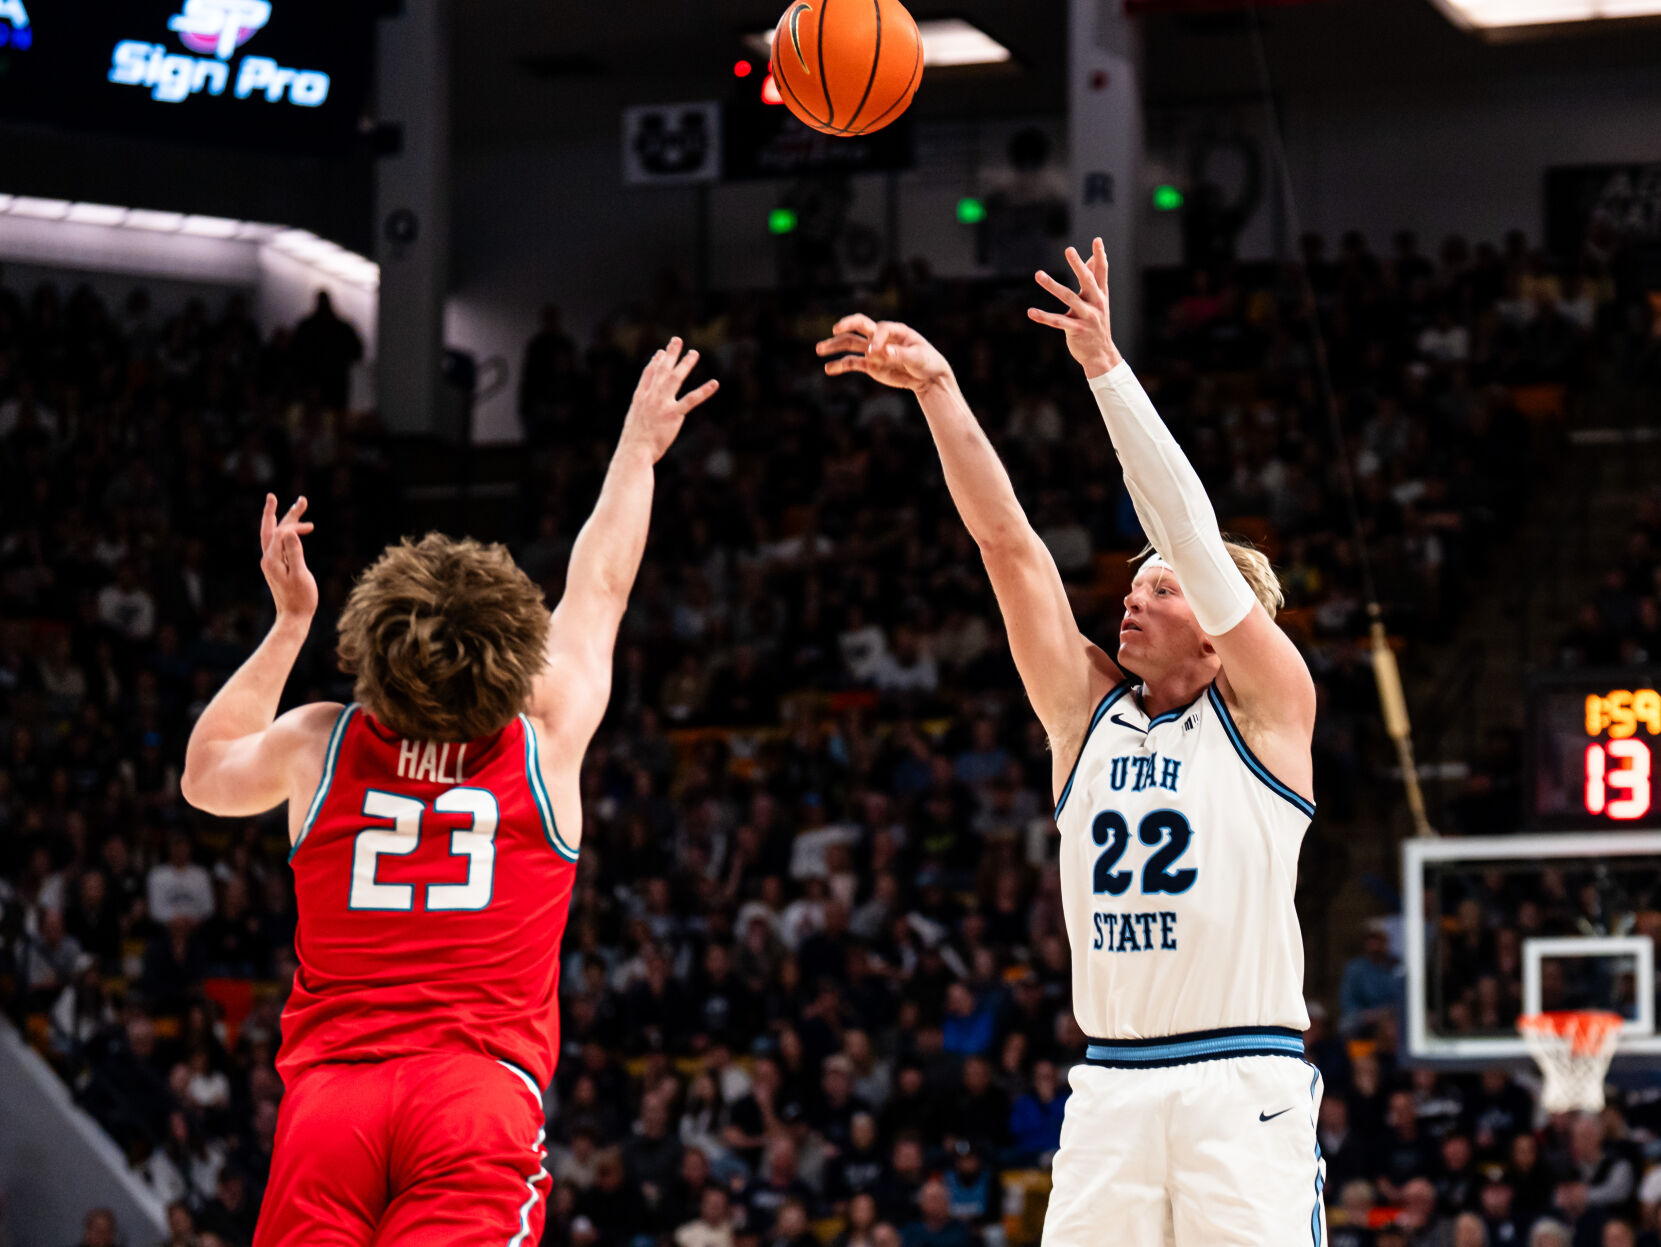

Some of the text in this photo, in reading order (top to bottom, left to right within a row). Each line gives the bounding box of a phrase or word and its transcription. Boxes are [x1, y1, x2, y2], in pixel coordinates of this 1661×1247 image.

[109, 40, 330, 106] Sign Pro
[1585, 689, 1661, 738] 1:59
[397, 738, 469, 784] HALL
[1109, 752, 1182, 792] UTAH
[1584, 737, 1651, 820] 13
[348, 786, 499, 912] 23
[1092, 808, 1198, 896] 22
[1093, 912, 1178, 952] STATE
